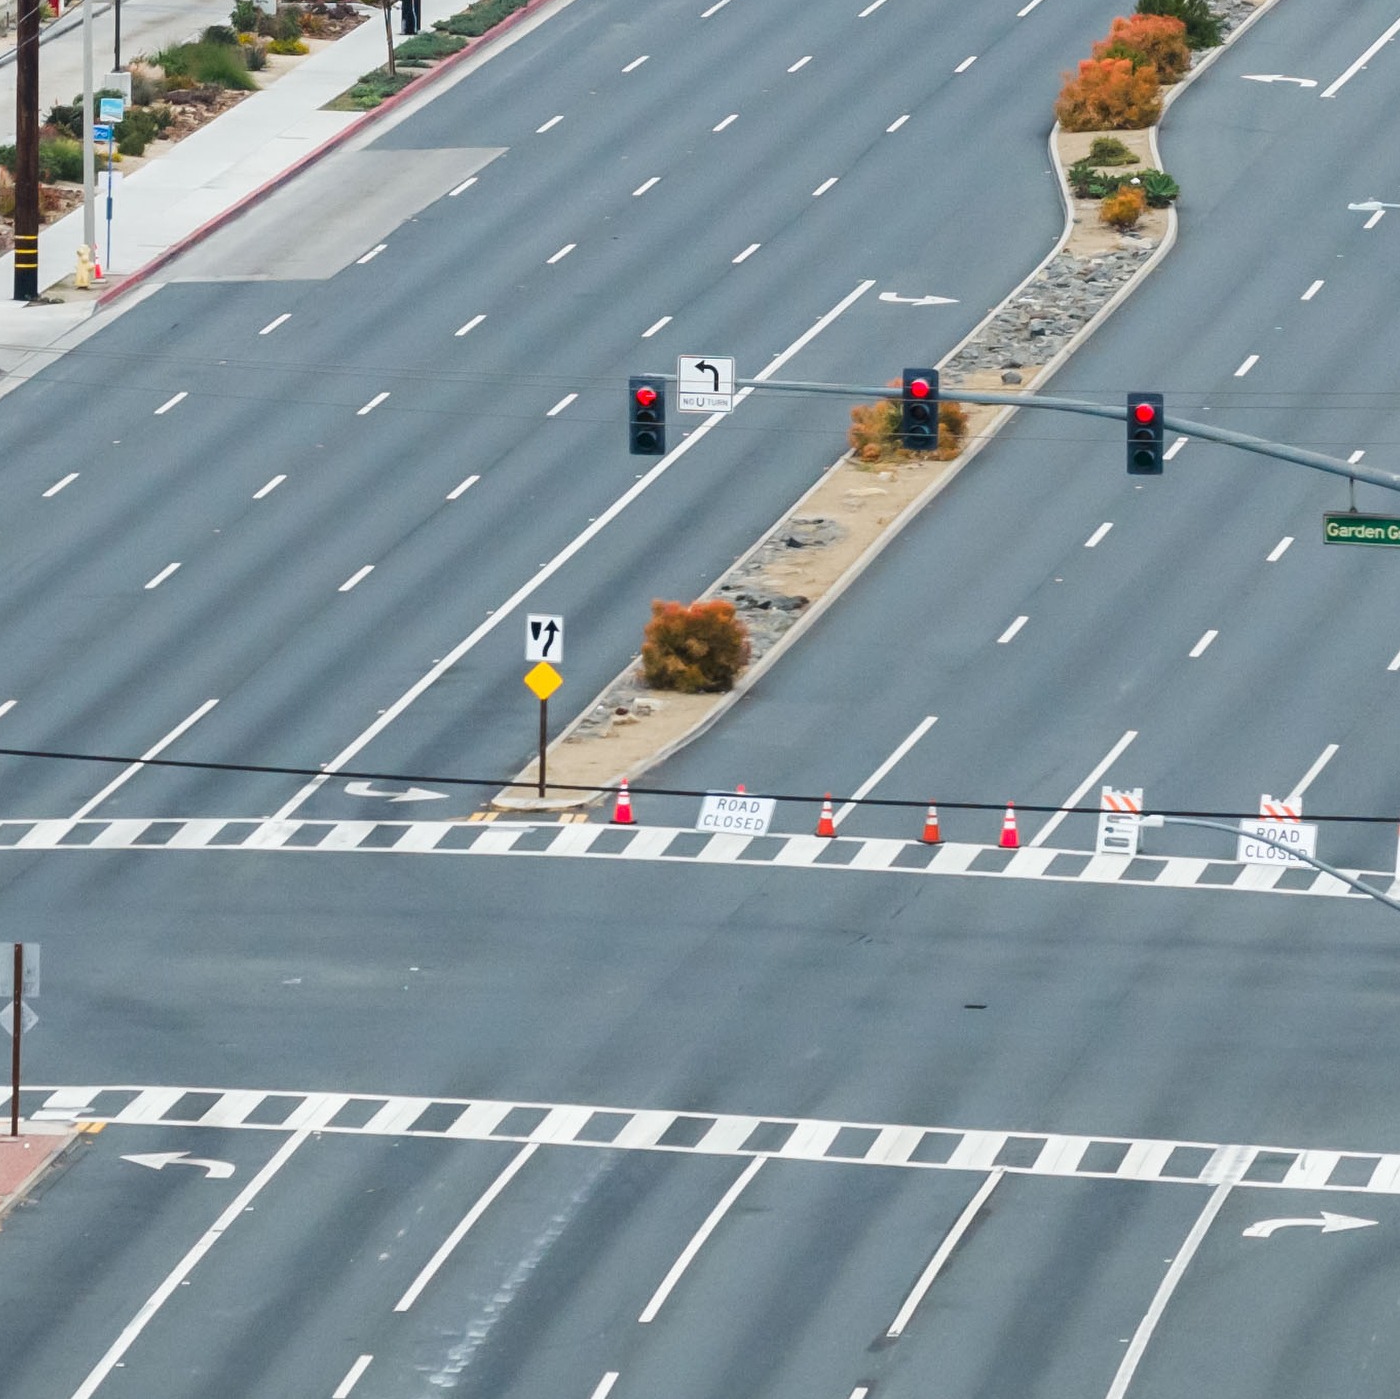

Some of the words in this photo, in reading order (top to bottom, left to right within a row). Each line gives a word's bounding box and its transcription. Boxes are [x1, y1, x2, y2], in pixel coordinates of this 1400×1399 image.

[1326, 522, 1385, 539] Garden
[716, 798, 760, 814] ROAD
[703, 815, 764, 831] CLOSED
